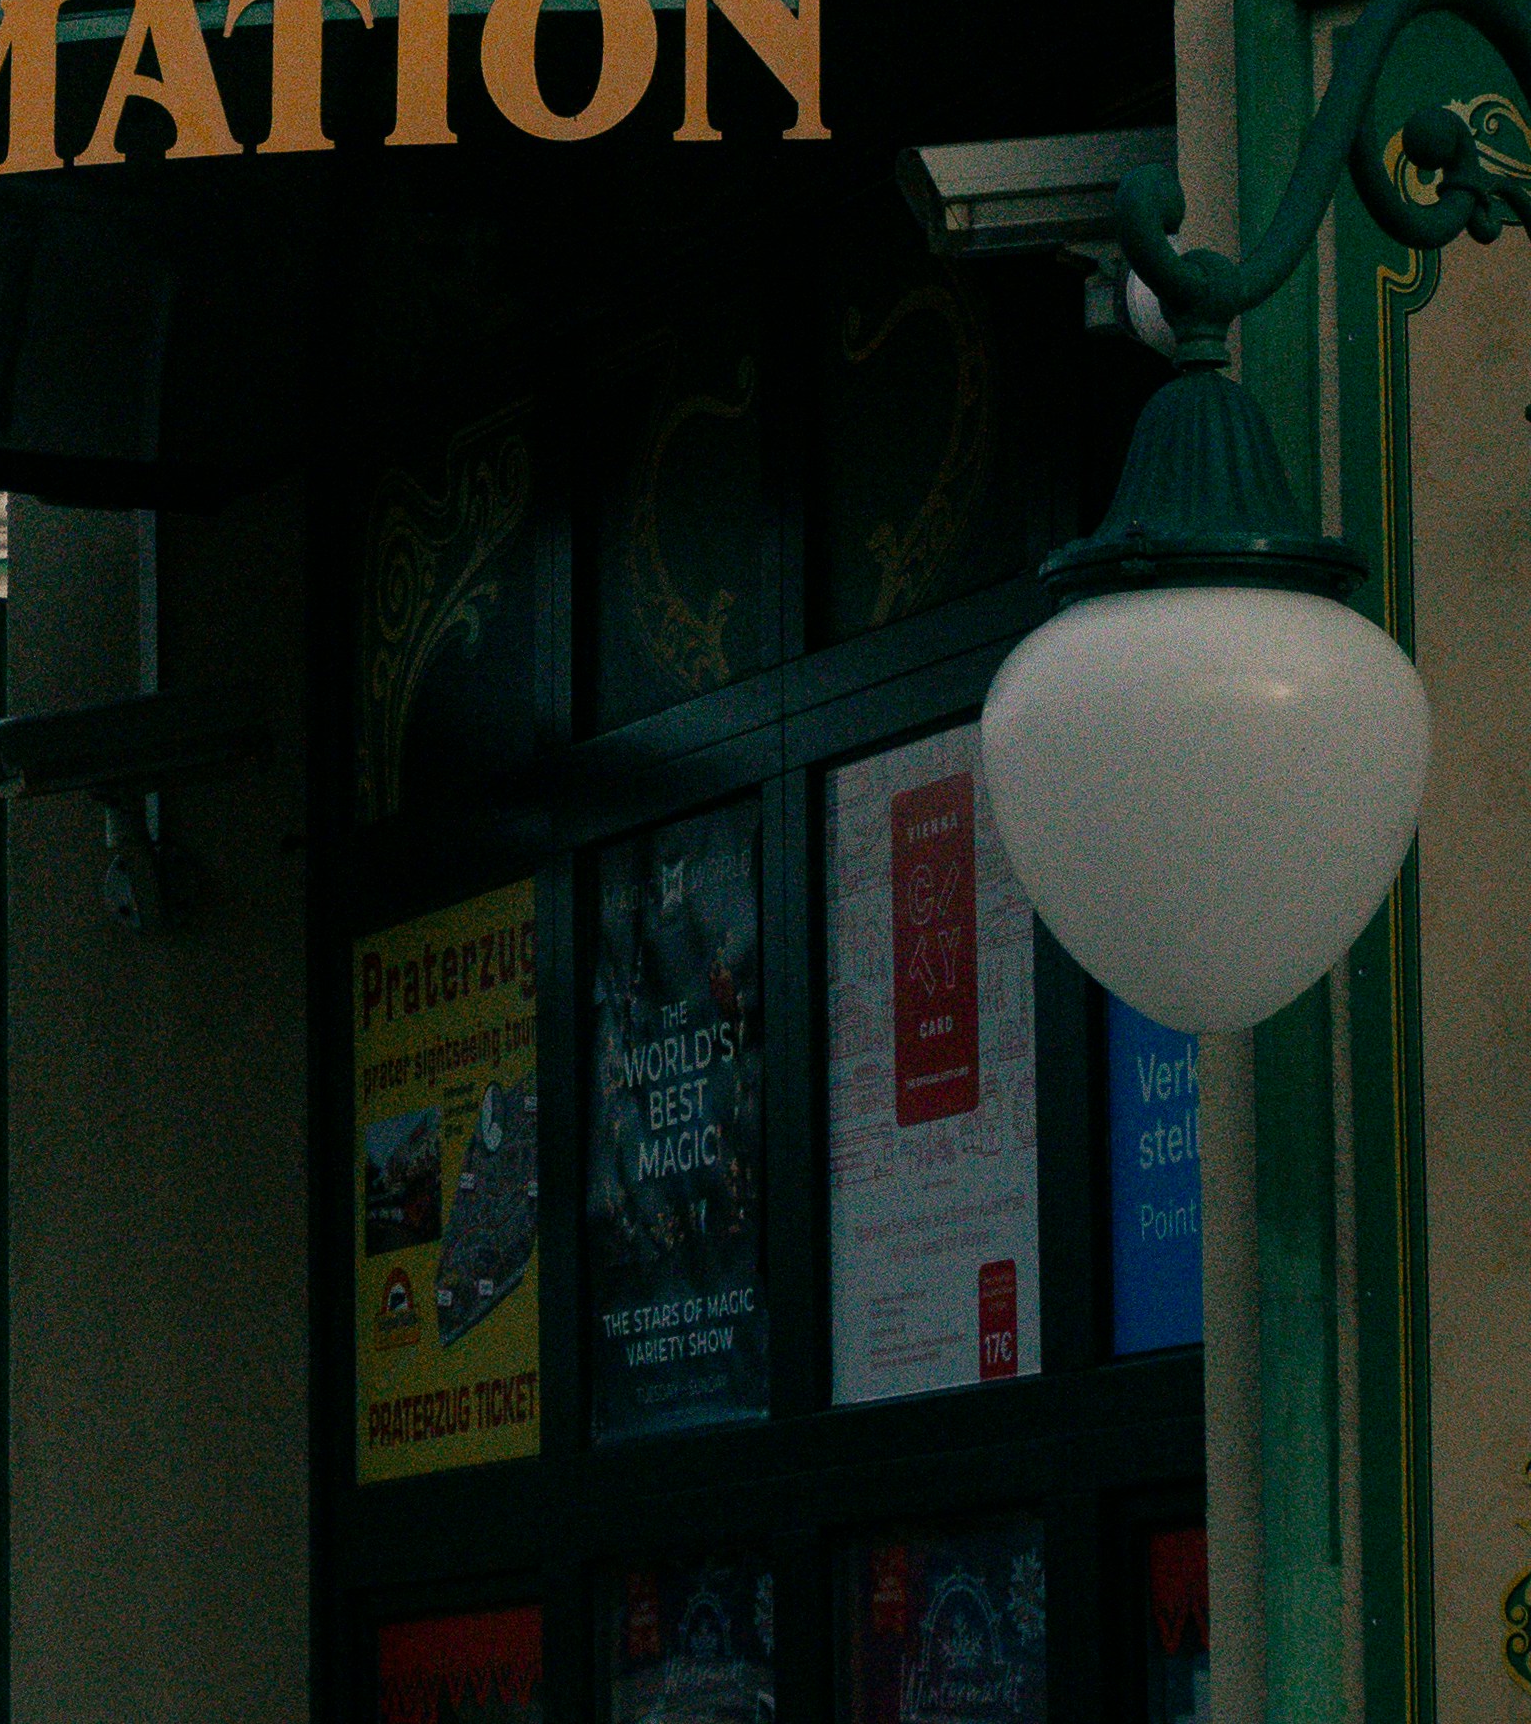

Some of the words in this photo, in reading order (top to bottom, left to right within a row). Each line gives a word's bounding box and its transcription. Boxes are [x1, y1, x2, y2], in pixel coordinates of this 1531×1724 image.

[906, 814, 957, 844] VIENNA
[362, 921, 537, 1027] Praterzug
[661, 1000, 688, 1028] THE
[919, 1015, 953, 1041] CARD
[624, 1022, 735, 1088] WORLD'S
[650, 1078, 708, 1131] BEST
[639, 1126, 717, 1181] MAGIC
[1140, 1198, 1199, 1242] Point
[602, 1312, 629, 1338] THE
[634, 1302, 680, 1333] STARS
[683, 1297, 704, 1323] OF
[707, 1288, 755, 1318] MAGIC
[626, 1334, 686, 1368] VARIETY
[689, 1326, 734, 1356] SHOW
[984, 1331, 1013, 1366] 17€
[369, 1386, 471, 1448] PRATERZUG
[475, 1372, 537, 1429] TICKET
